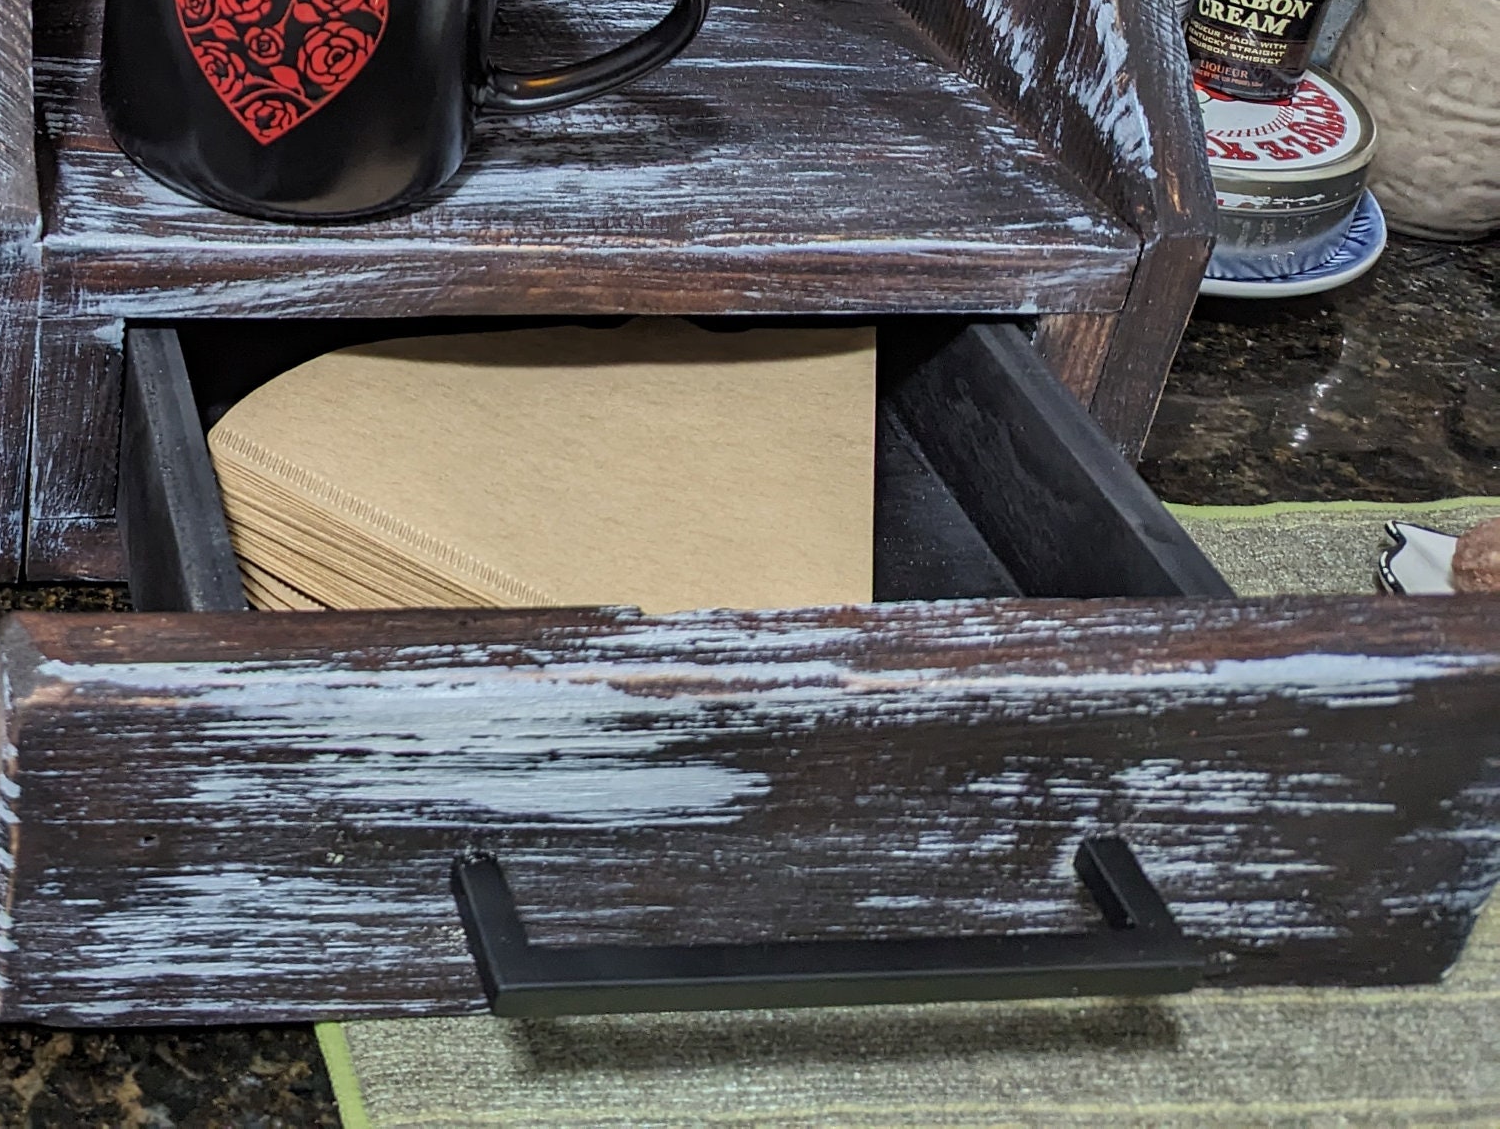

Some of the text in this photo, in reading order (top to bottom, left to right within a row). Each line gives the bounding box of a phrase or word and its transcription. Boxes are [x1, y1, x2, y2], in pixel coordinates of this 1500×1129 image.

[1229, 43, 1286, 57] STRAIGHT
[1260, 41, 1287, 50] WITH
[1231, 52, 1281, 64] WHISKEY
[1200, 60, 1248, 79] LIQUEUR
